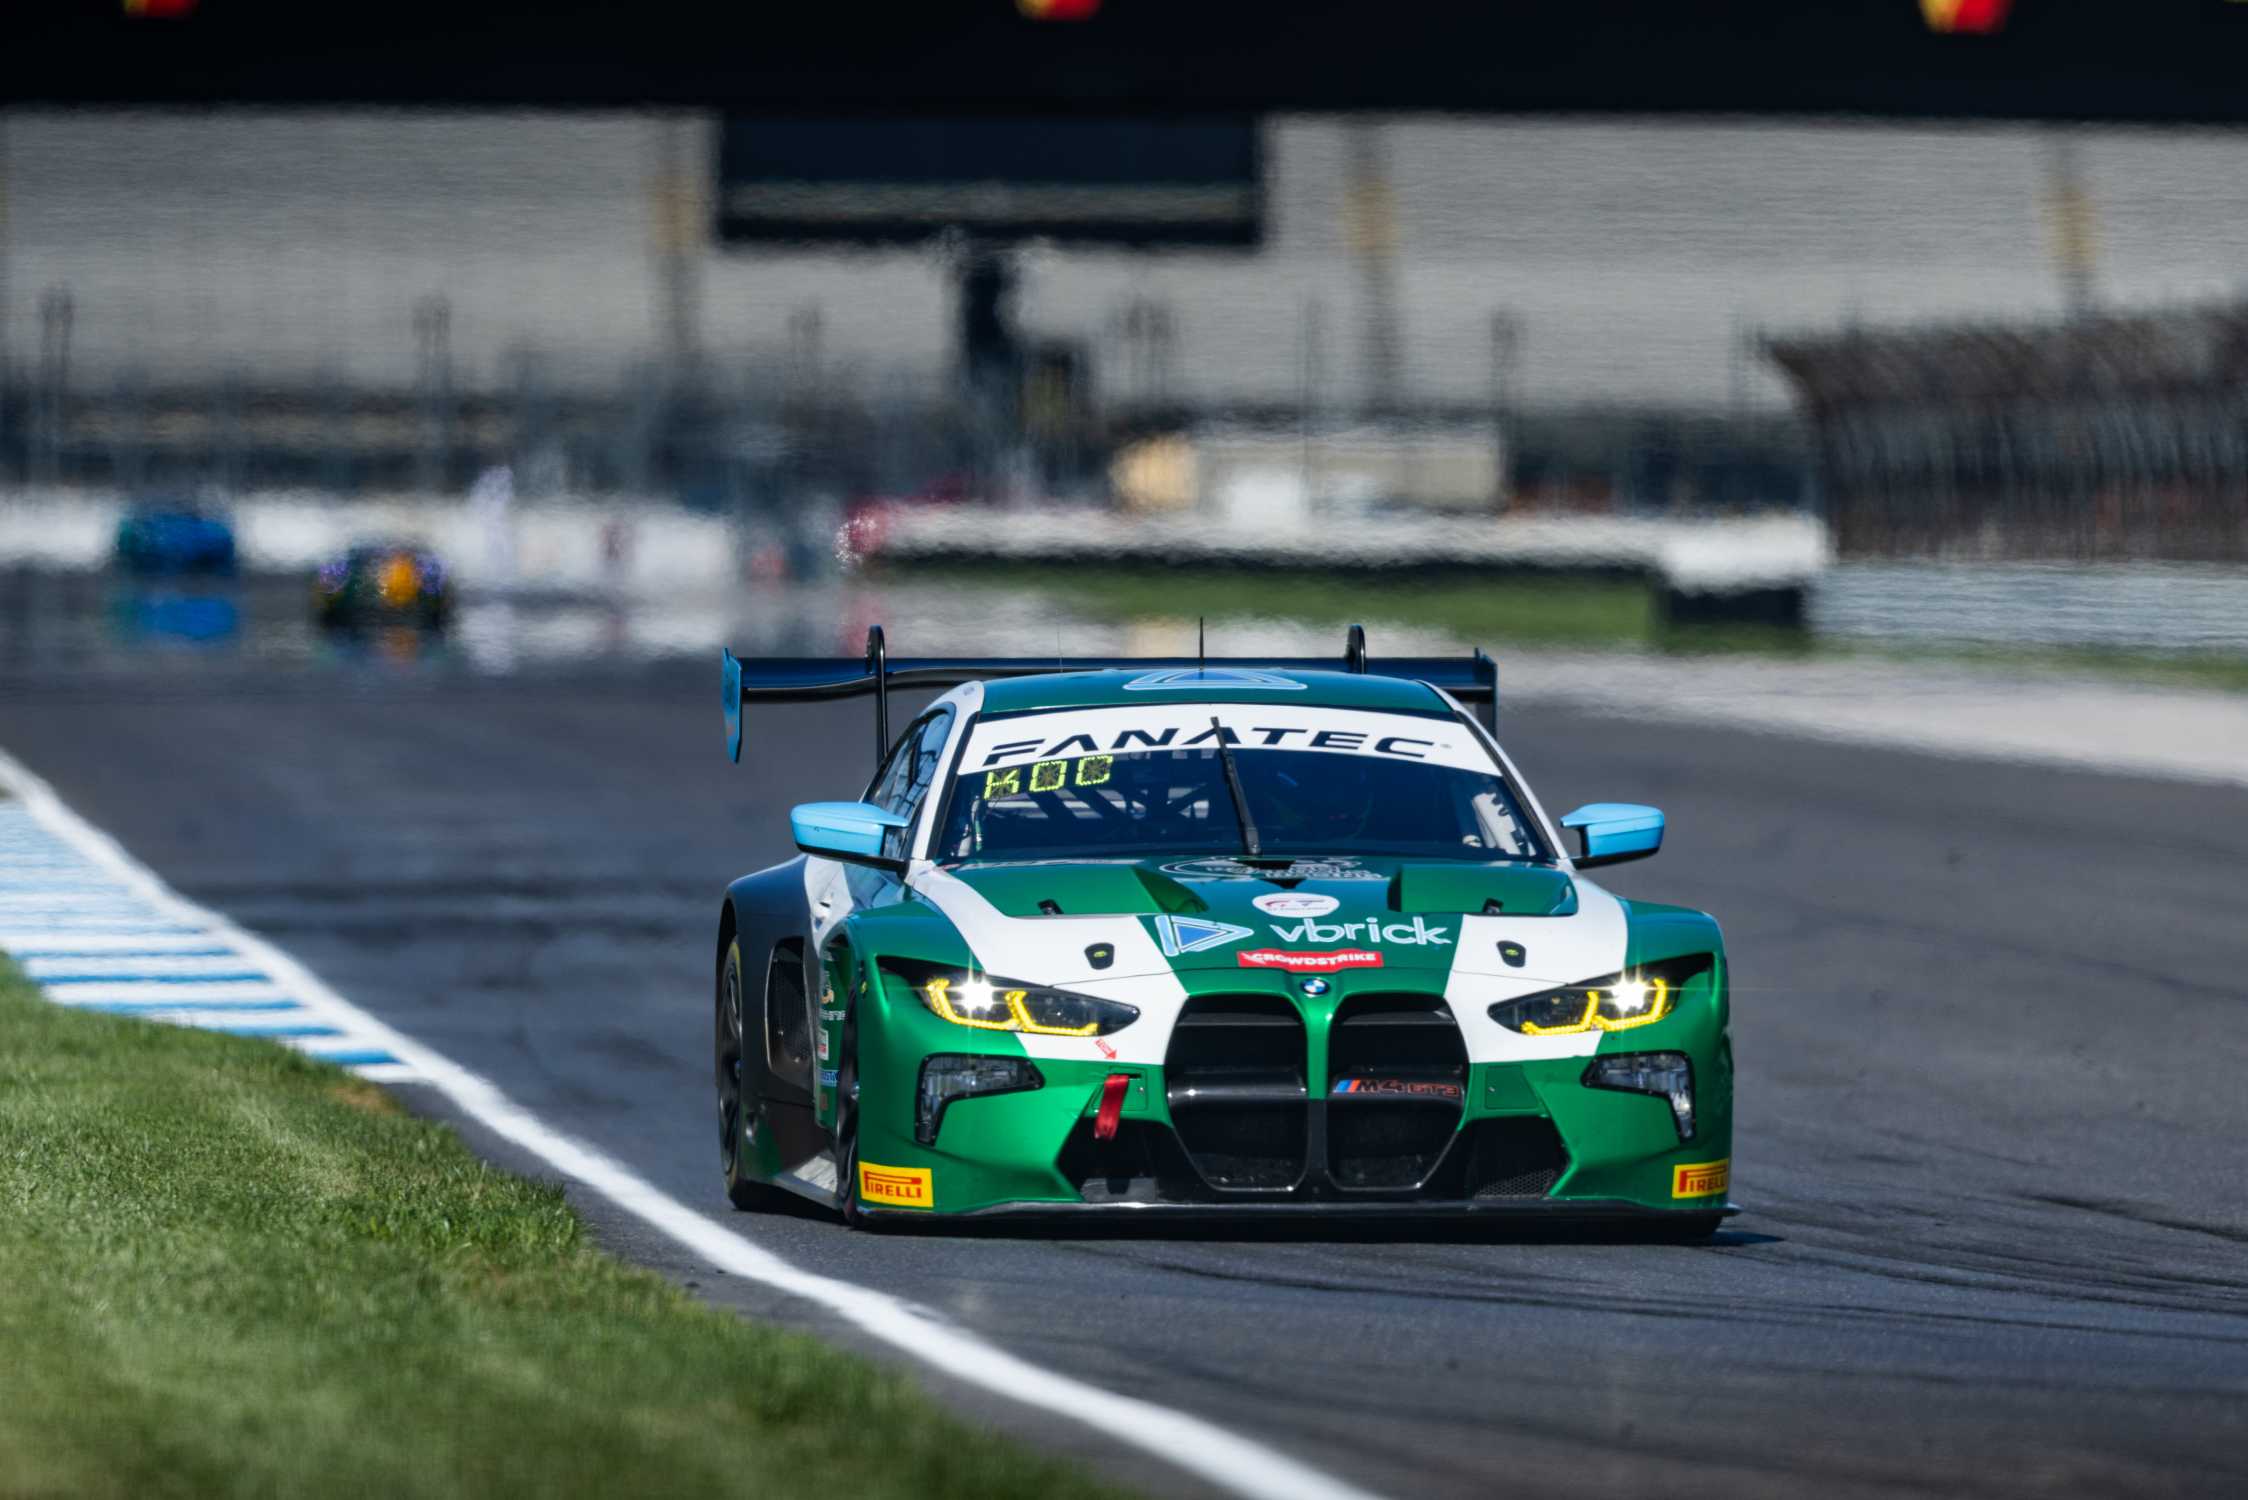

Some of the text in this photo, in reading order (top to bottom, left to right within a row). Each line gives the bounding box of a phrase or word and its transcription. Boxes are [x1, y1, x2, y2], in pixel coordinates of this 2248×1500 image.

[983, 727, 1435, 768] FANATEC
[1269, 917, 1452, 945] vbrick
[1250, 952, 1377, 966] CROWDSTRIKE
[864, 1170, 922, 1198] PIRELLI
[1679, 1164, 1728, 1193] PIRELL
